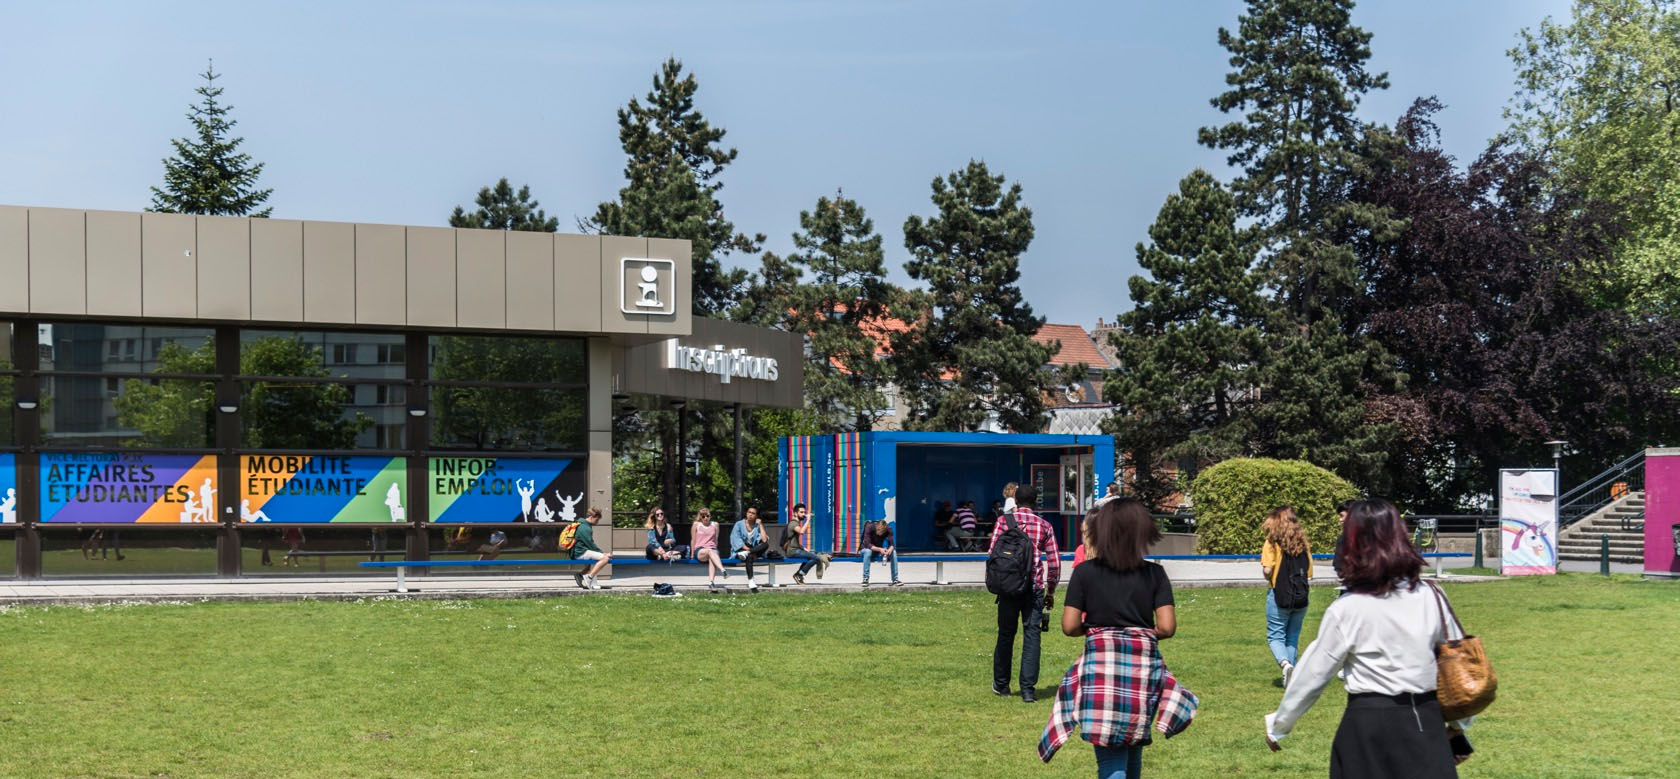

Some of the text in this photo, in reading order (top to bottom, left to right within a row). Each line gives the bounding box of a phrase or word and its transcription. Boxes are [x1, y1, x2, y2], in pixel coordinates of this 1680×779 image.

[668, 338, 778, 384] Inscriptions
[47, 463, 155, 482] AFFAIRES
[435, 458, 504, 476] INFOR-
[48, 479, 190, 503] ÉTUDIANTES
[249, 474, 367, 496] ÉTUDIANTE
[435, 477, 513, 495] EMPLOI
